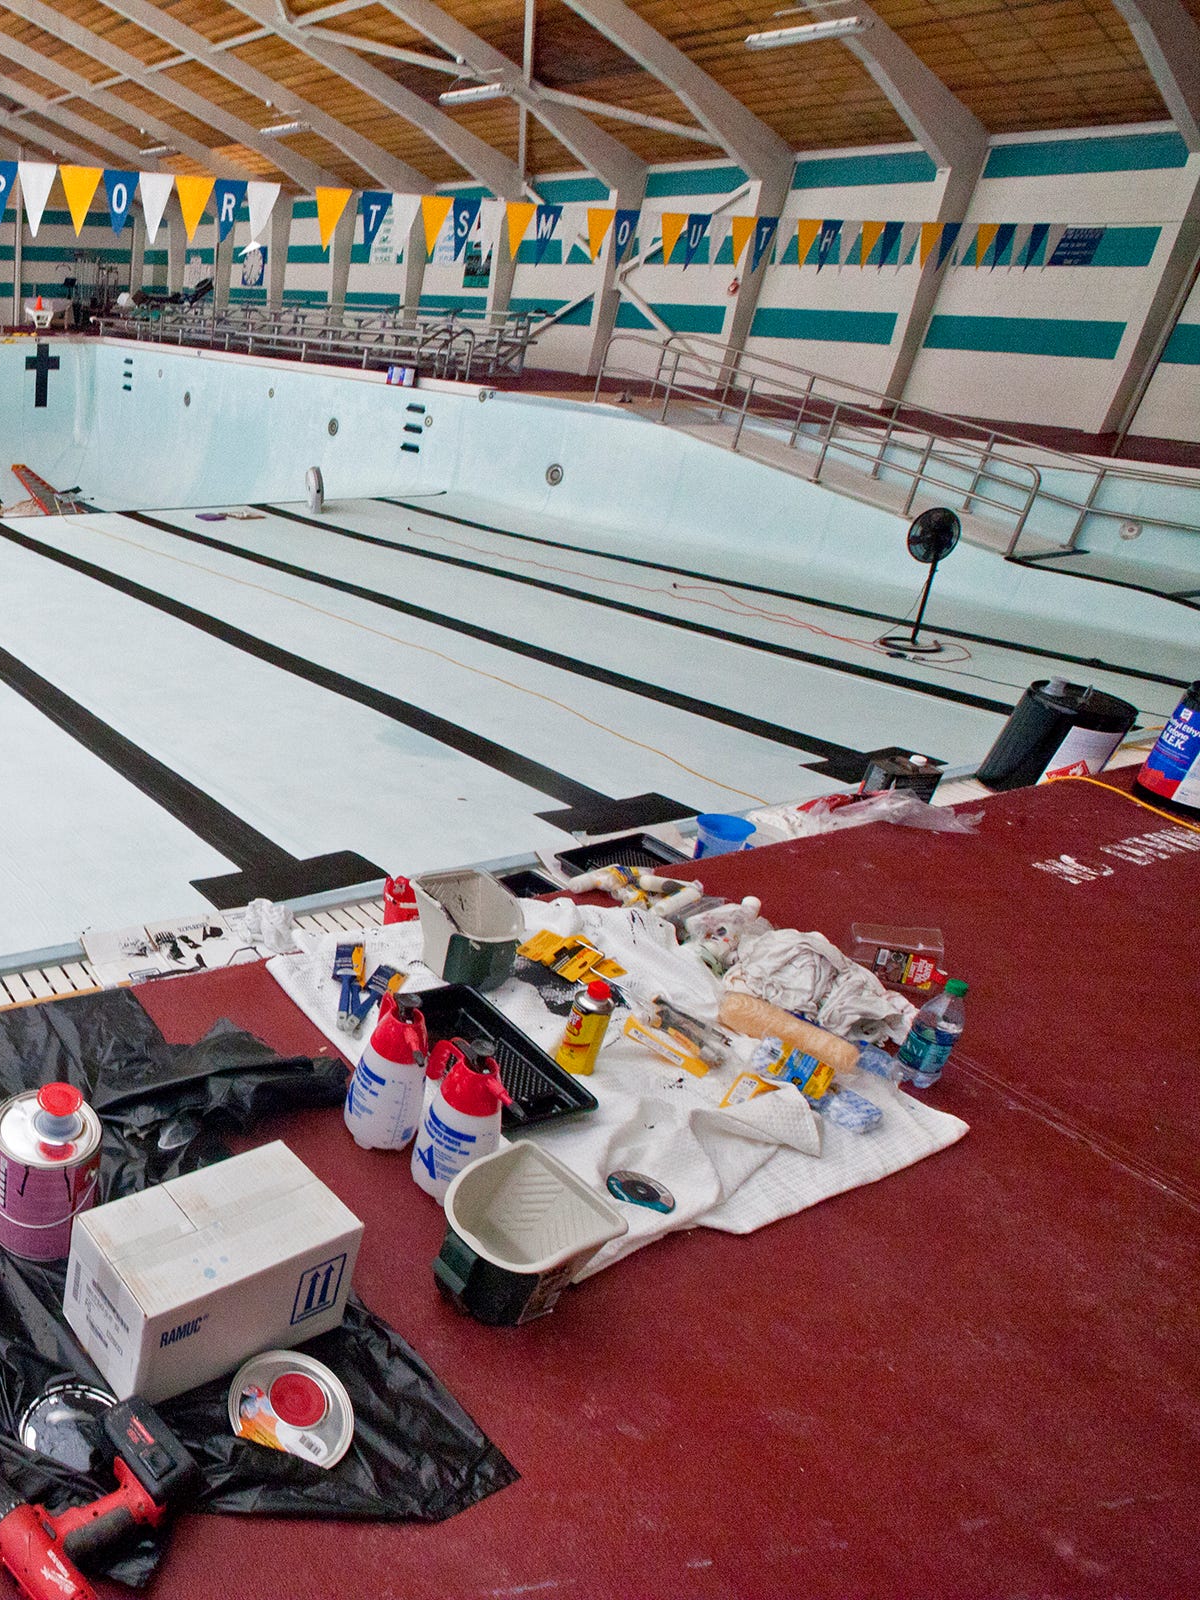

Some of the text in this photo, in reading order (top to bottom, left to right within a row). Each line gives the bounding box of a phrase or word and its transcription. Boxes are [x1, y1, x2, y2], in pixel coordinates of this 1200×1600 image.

[112, 183, 127, 214] O
[220, 193, 236, 222] R
[370, 205, 381, 232] T
[457, 210, 470, 237] S
[537, 213, 554, 240] M
[618, 220, 630, 246] O
[690, 224, 702, 248] U
[759, 227, 771, 250] T
[820, 230, 835, 251] H
[1182, 724, 1200, 737] Ethy
[160, 1317, 203, 1348] RAMUC
